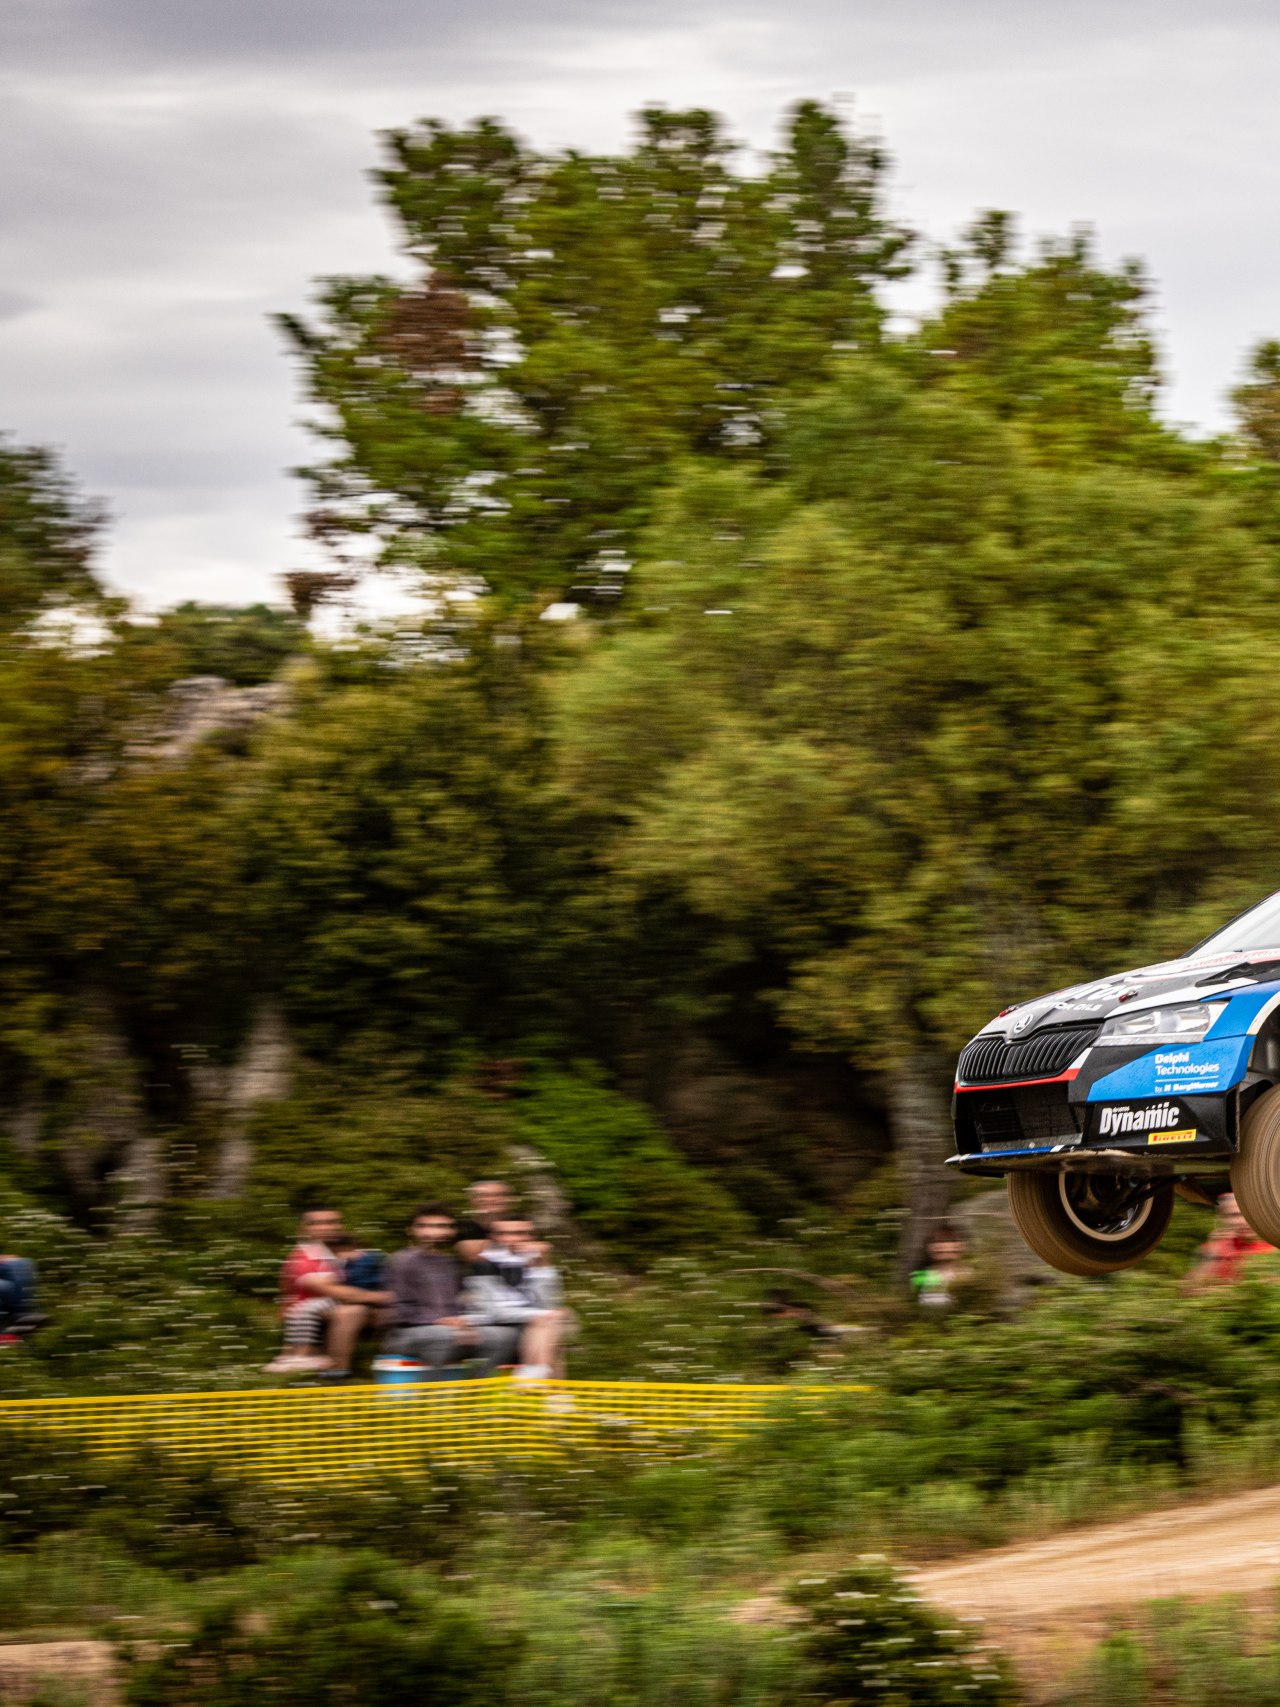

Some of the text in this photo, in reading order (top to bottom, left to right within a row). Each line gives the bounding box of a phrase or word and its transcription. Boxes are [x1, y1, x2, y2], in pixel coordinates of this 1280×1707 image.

[1155, 1052, 1190, 1065] Delphi
[1155, 1062, 1220, 1077] Technologies
[1173, 1081, 1220, 1093] BorgWarner
[1099, 1101, 1180, 1136] Dynamic
